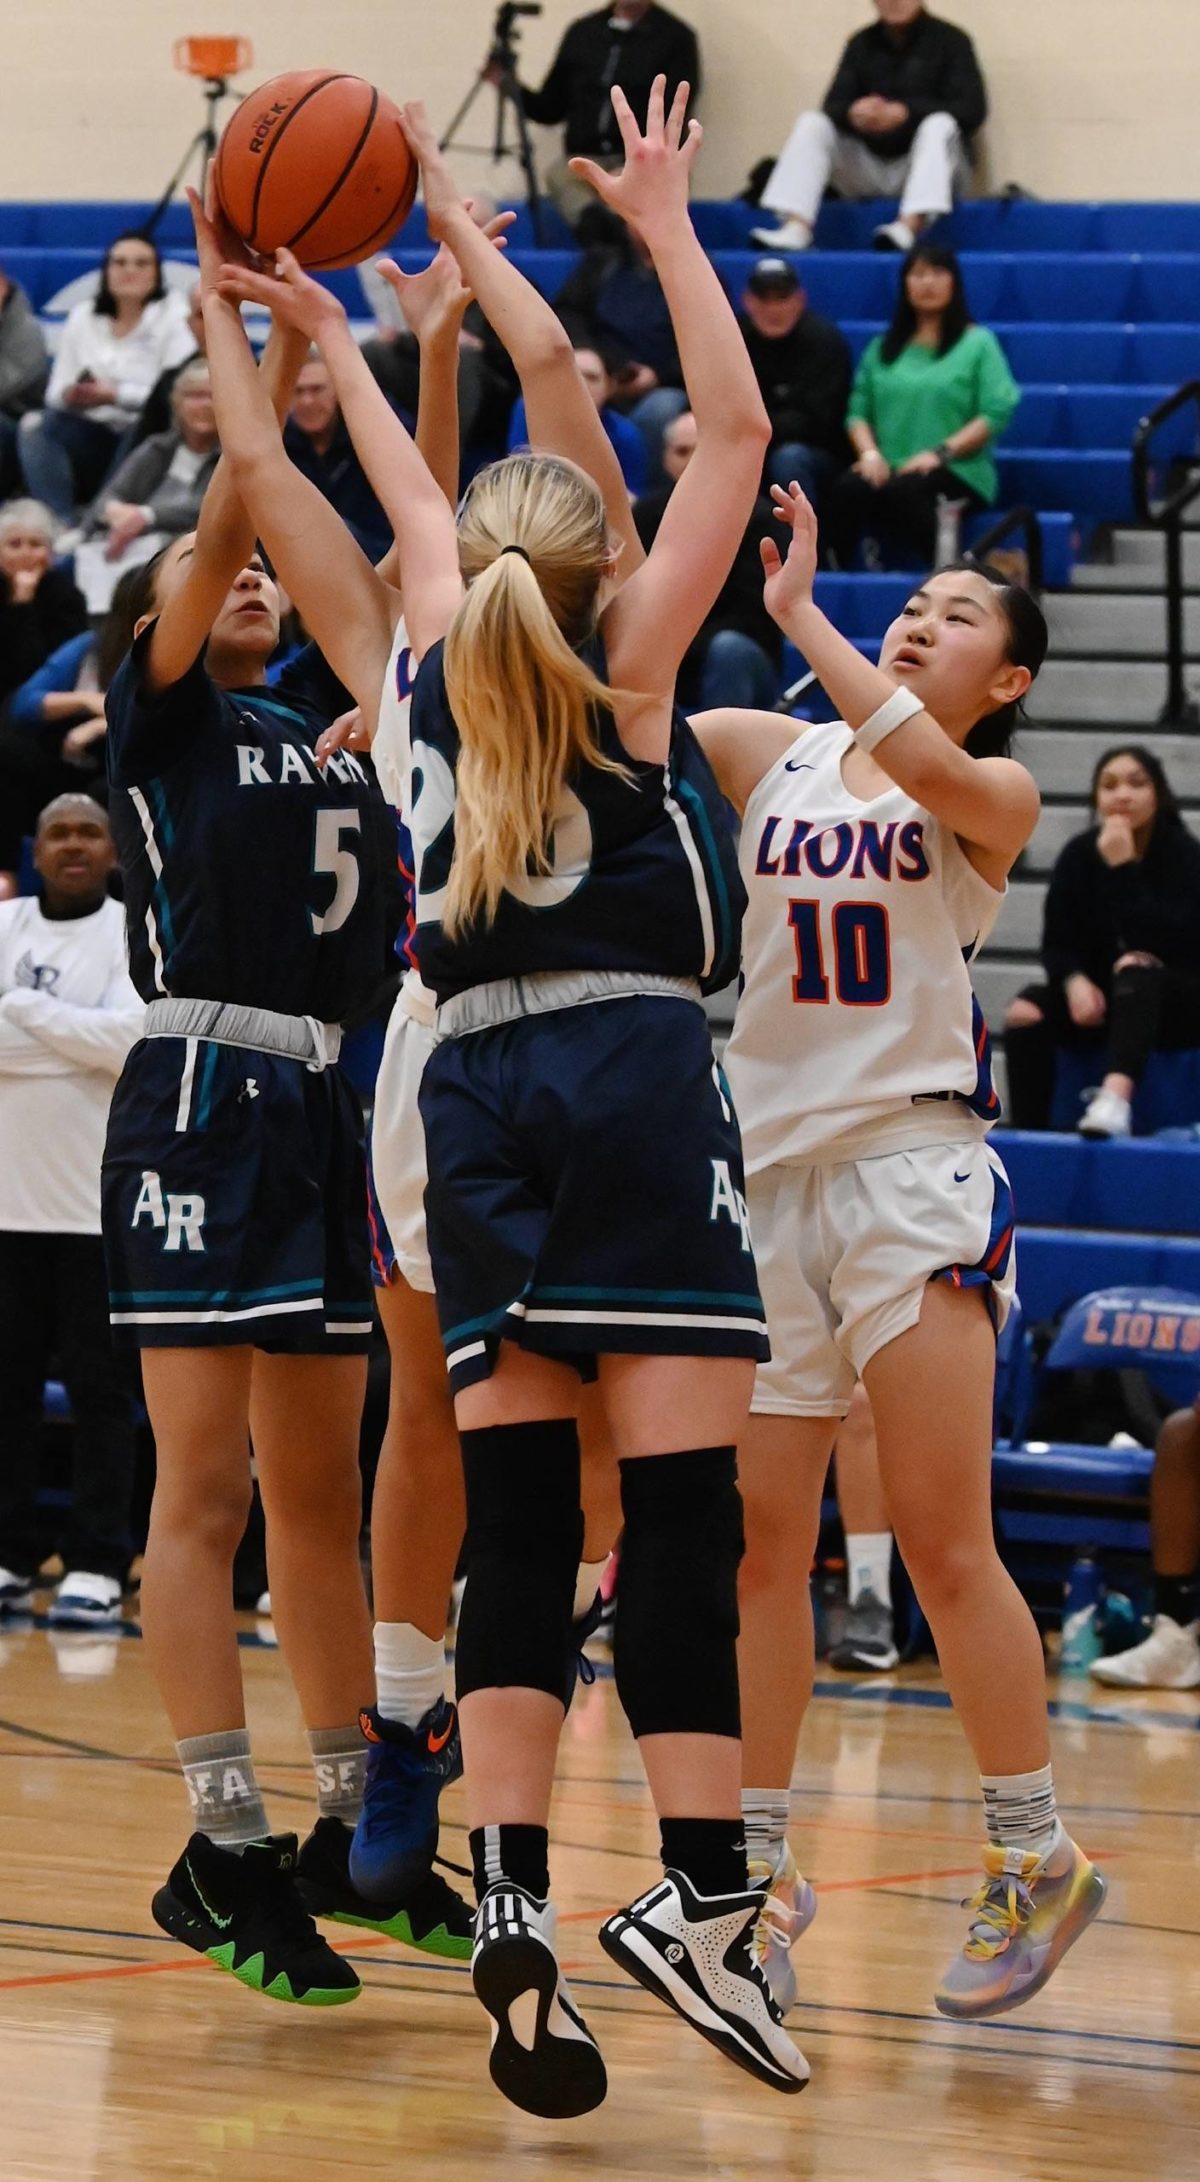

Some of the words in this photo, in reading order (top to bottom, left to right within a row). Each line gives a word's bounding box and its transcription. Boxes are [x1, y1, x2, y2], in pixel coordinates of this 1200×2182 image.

[249, 102, 289, 154] ROCK
[309, 806, 362, 936] 5
[755, 815, 930, 882] LIONS
[787, 898, 892, 1007] 10
[1083, 1308, 1200, 1352] LIONS
